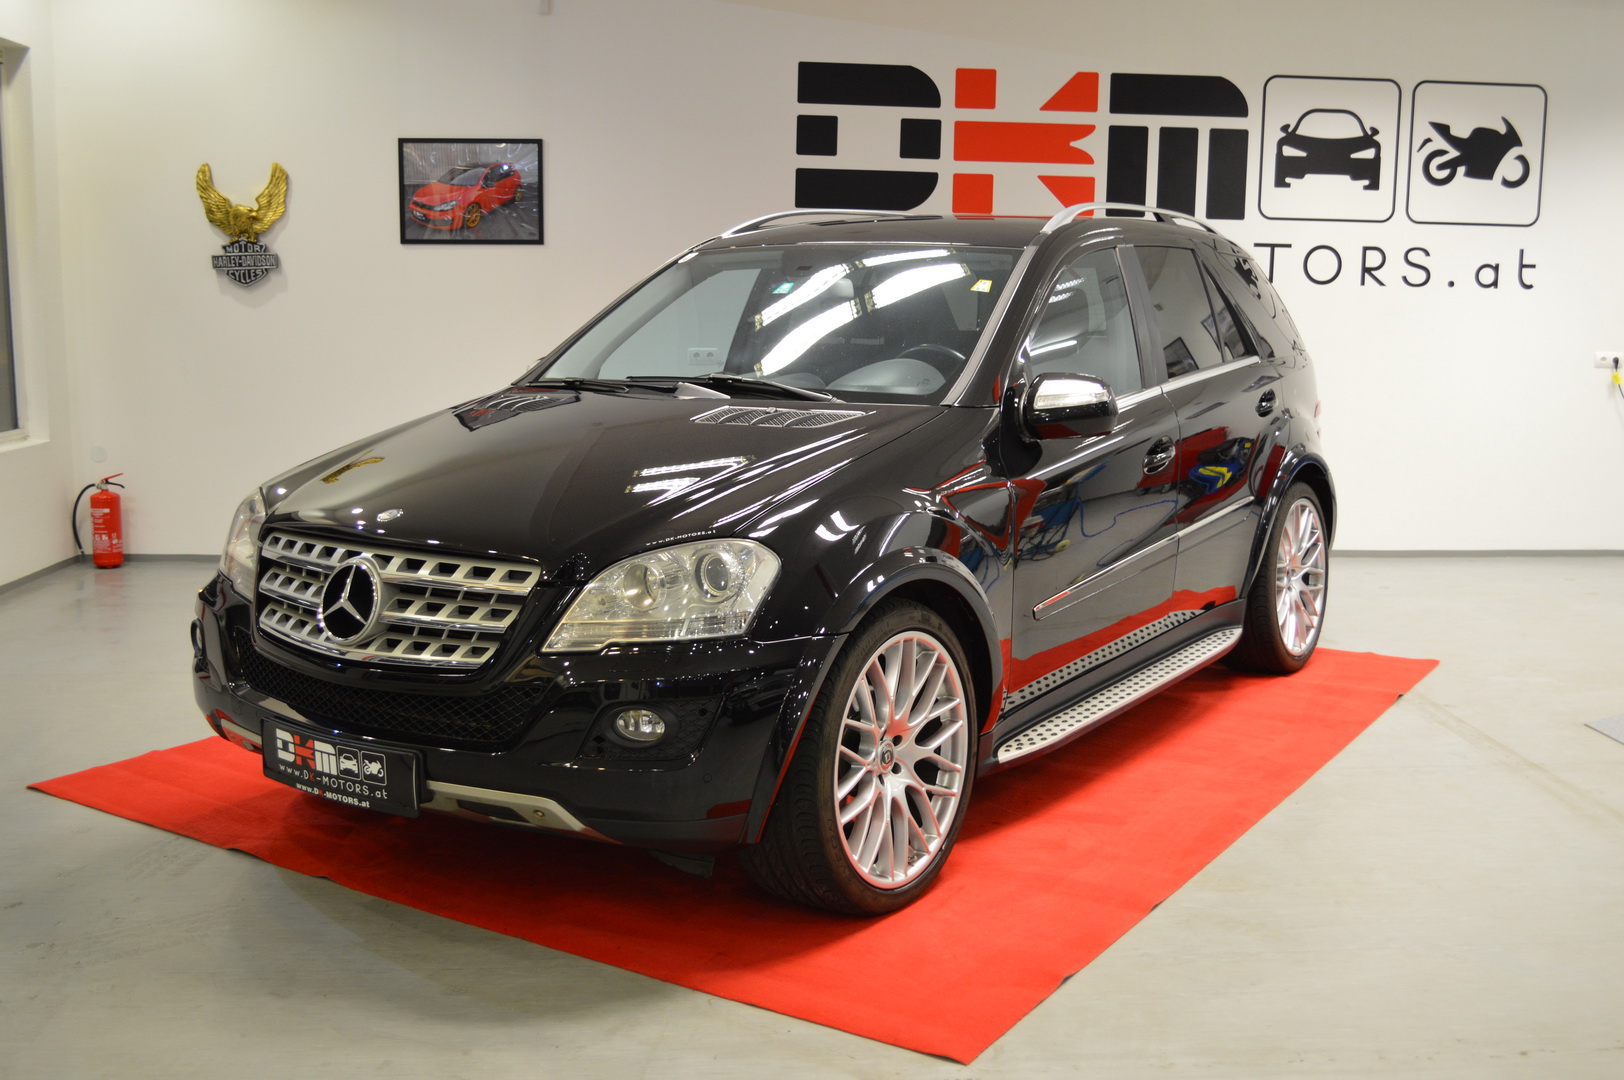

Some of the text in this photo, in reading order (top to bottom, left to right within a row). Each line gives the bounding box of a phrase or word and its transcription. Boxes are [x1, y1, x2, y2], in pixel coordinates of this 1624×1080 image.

[226, 242, 261, 253] MOTOR
[213, 256, 276, 267] HARLEY-DAVIDSON
[229, 269, 263, 283] CYCLES
[279, 763, 388, 800] www.DK-MOTORS.at
[296, 782, 370, 809] www.DK-MOTORS.at
